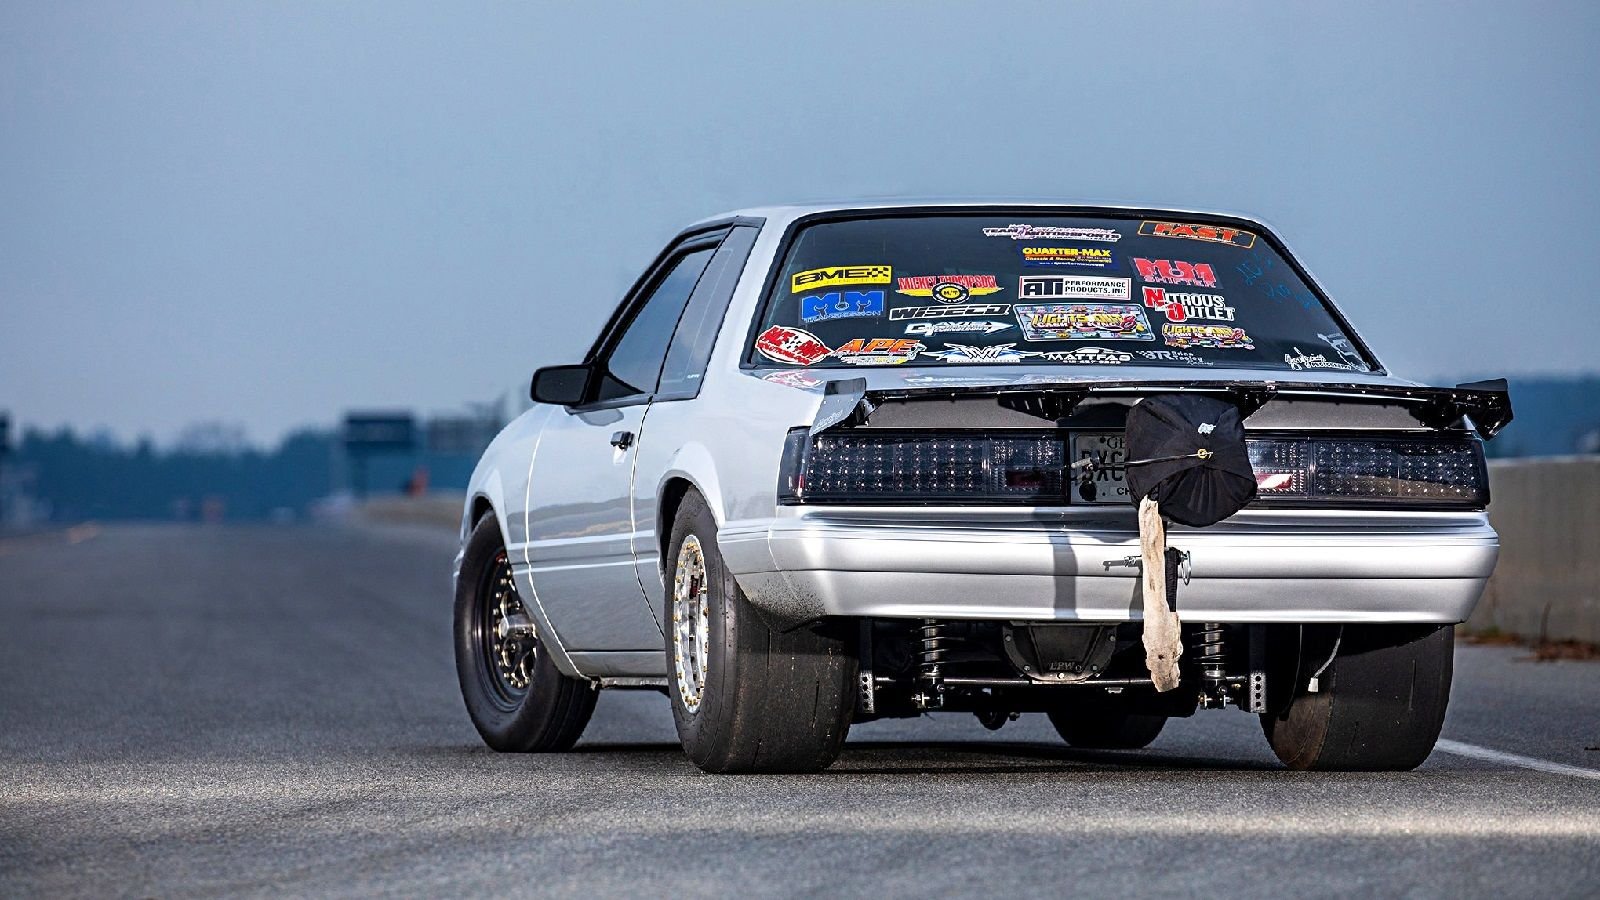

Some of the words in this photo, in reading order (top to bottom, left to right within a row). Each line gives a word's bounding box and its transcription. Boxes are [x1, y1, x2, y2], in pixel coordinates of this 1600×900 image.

[1154, 223, 1238, 243] FAST
[1022, 247, 1112, 257] QUARTER-MAX
[897, 276, 937, 291] MICKEY
[1023, 278, 1064, 296] ATI
[1064, 280, 1126, 288] PERFORMANCE
[1142, 286, 1225, 308] NITROUS
[889, 304, 1011, 321] WISECO
[1031, 313, 1089, 327] LIGHTS
[1165, 302, 1236, 322] OUTLET
